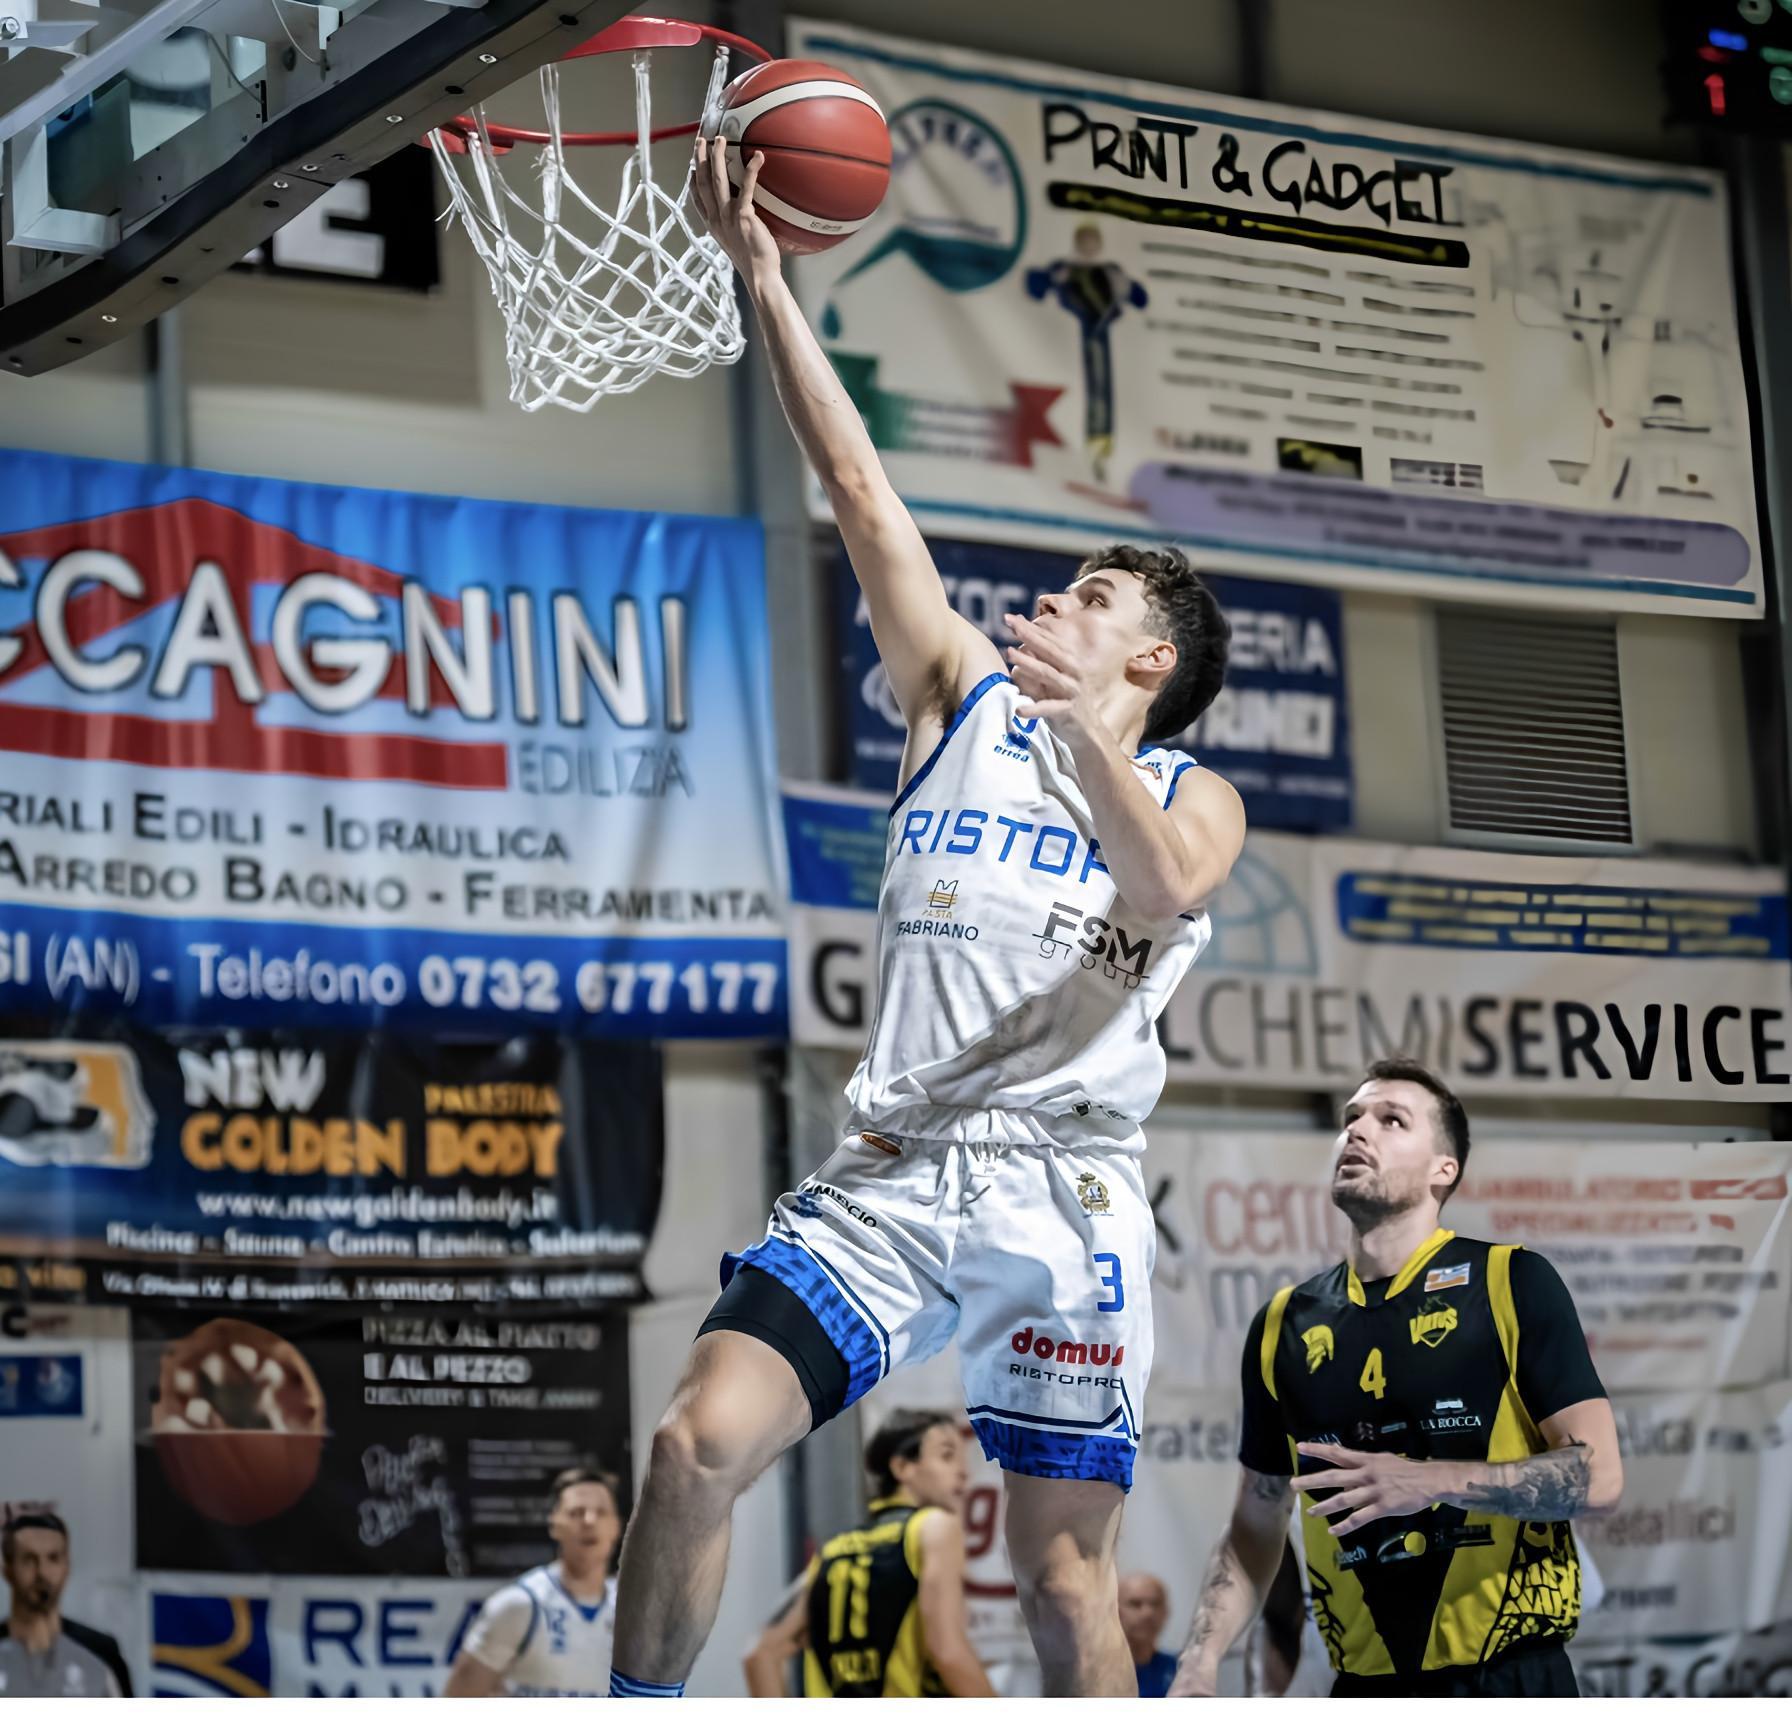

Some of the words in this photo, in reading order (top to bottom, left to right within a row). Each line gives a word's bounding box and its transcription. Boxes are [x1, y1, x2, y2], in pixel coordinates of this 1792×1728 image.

[1042, 102, 1199, 189] PRINT
[1212, 133, 1253, 197] &
[0, 547, 690, 735] CAGNINI
[224, 855, 408, 911] BAGNO
[464, 871, 776, 923] FERRAMENTA
[896, 919, 979, 942] FABRIANO
[1042, 900, 1154, 978] FSM
[45, 932, 140, 1005] (AN)
[187, 943, 406, 1007] Telefono
[418, 954, 561, 1014] 0732
[576, 960, 779, 1014] 677177
[177, 1047, 327, 1113] NEW
[180, 1111, 407, 1179] GOLDEN
[425, 1119, 564, 1178] BODY
[1093, 1252, 1125, 1313] 3
[1011, 1326, 1125, 1368] domus
[1359, 1347, 1386, 1400] 4
